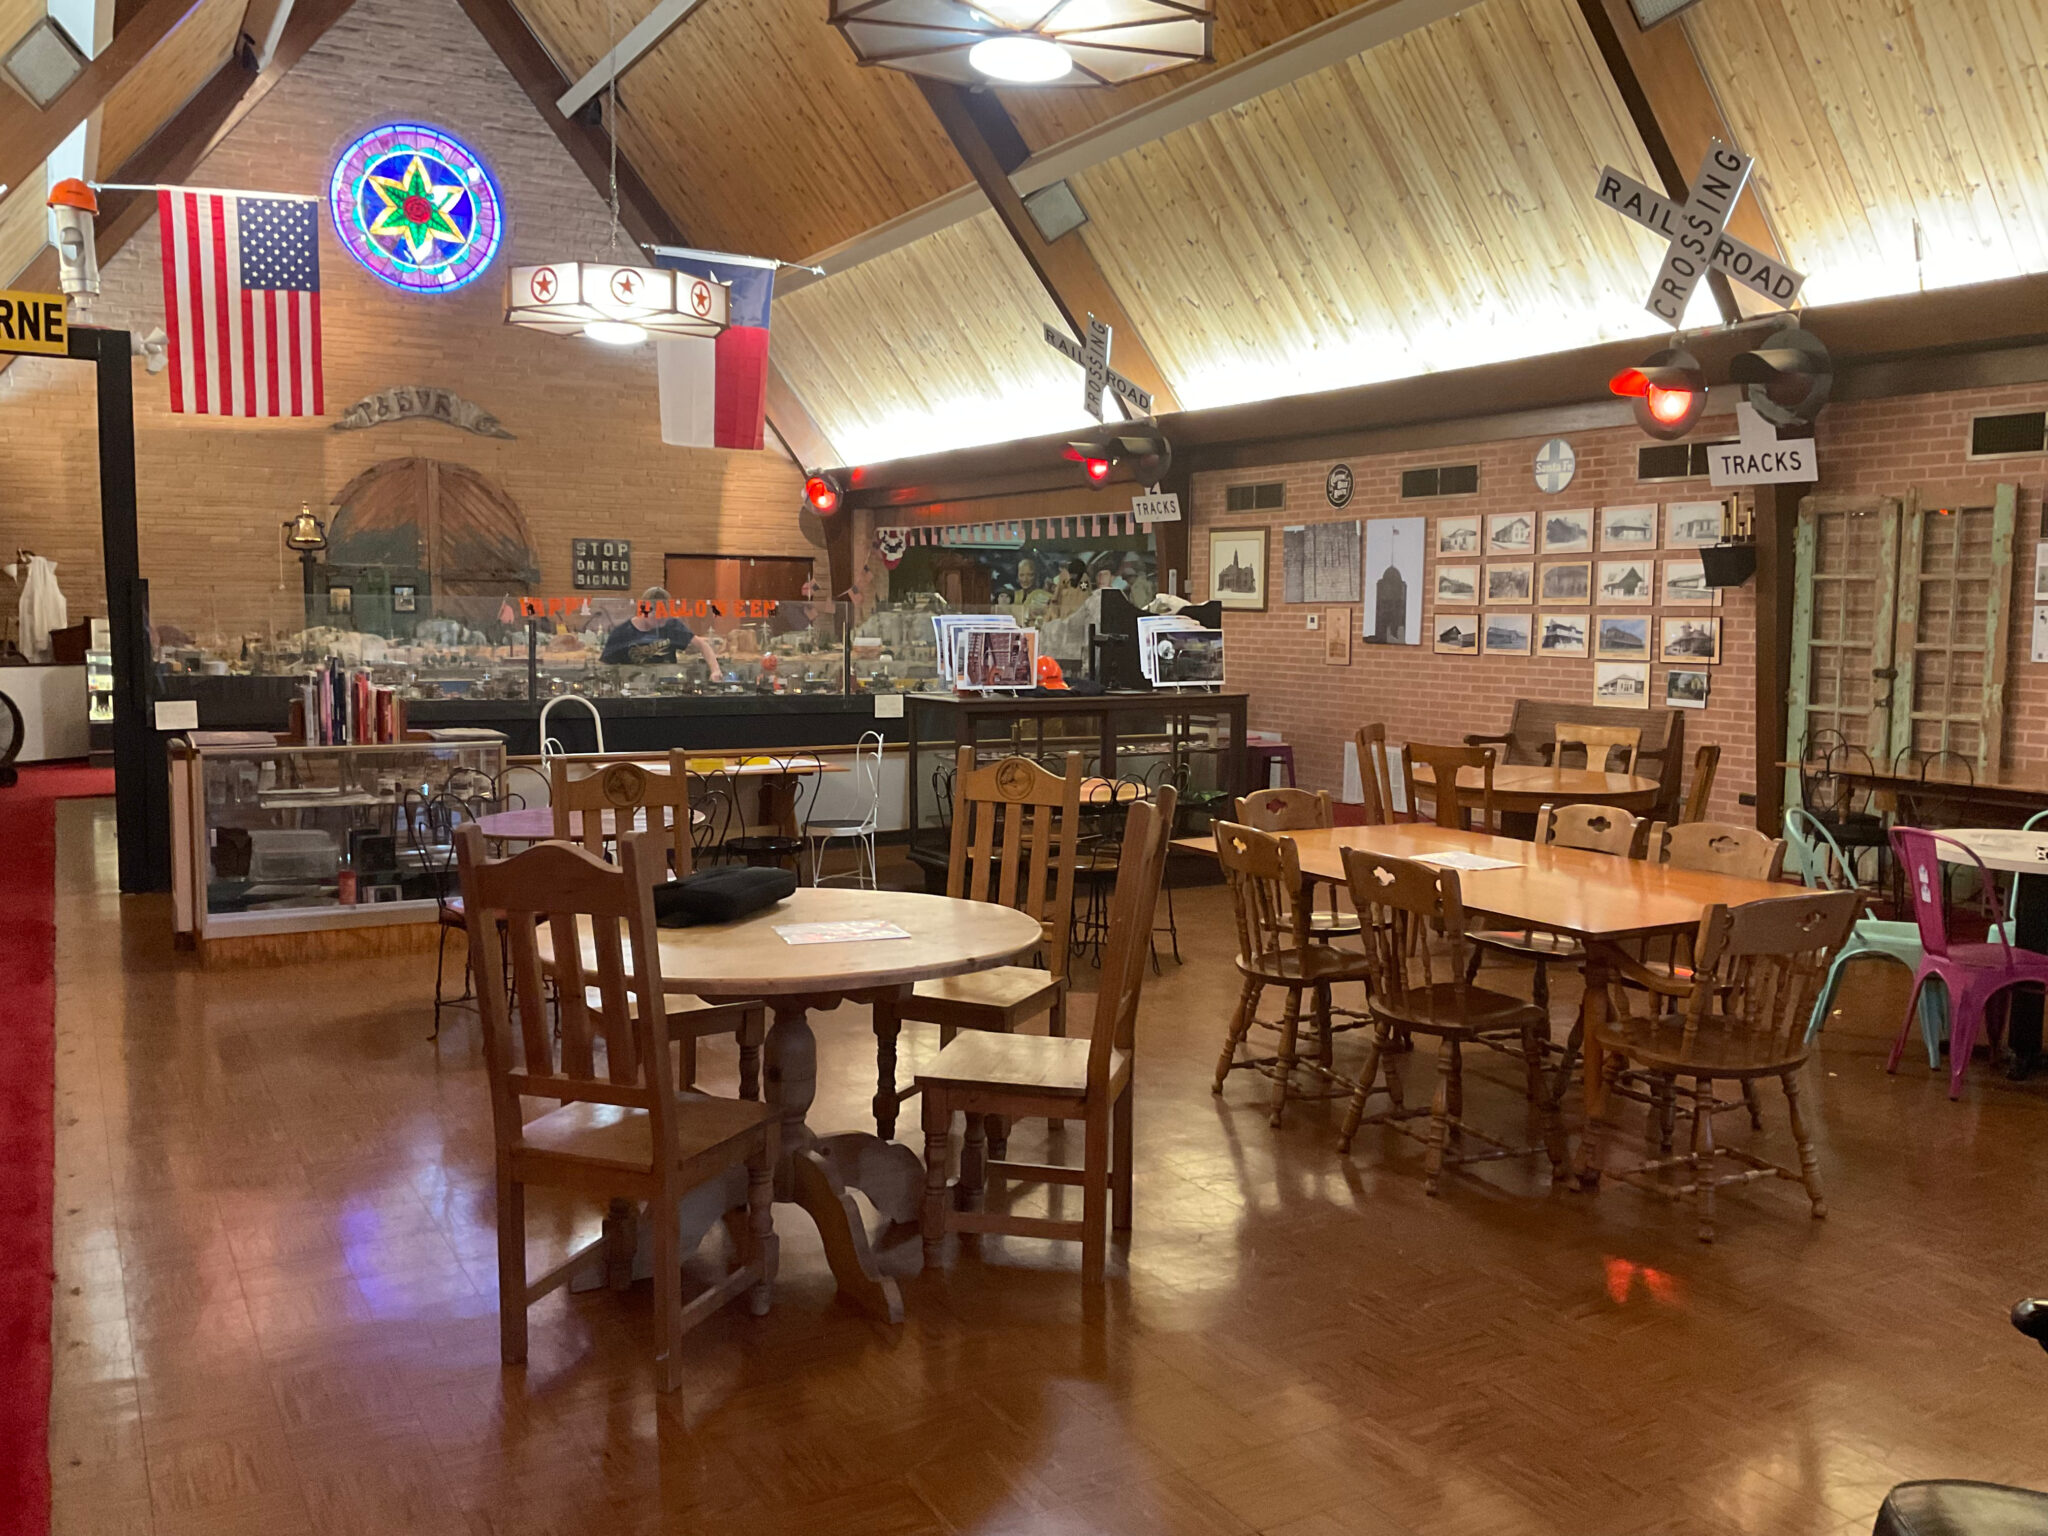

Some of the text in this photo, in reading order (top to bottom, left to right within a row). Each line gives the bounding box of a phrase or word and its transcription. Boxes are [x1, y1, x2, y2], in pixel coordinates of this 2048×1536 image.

[1602, 176, 1795, 300] RAIL ROAD
[1654, 150, 1741, 320] CROSSING
[1046, 328, 1149, 409] RAIL ROAD
[1087, 320, 1106, 418] CROSSING
[1721, 450, 1802, 475] TRACKS
[1136, 500, 1177, 516] TRACKS
[576, 542, 628, 557] STOP
[577, 559, 629, 571] ON RED
[577, 574, 629, 586] SIGNAL
